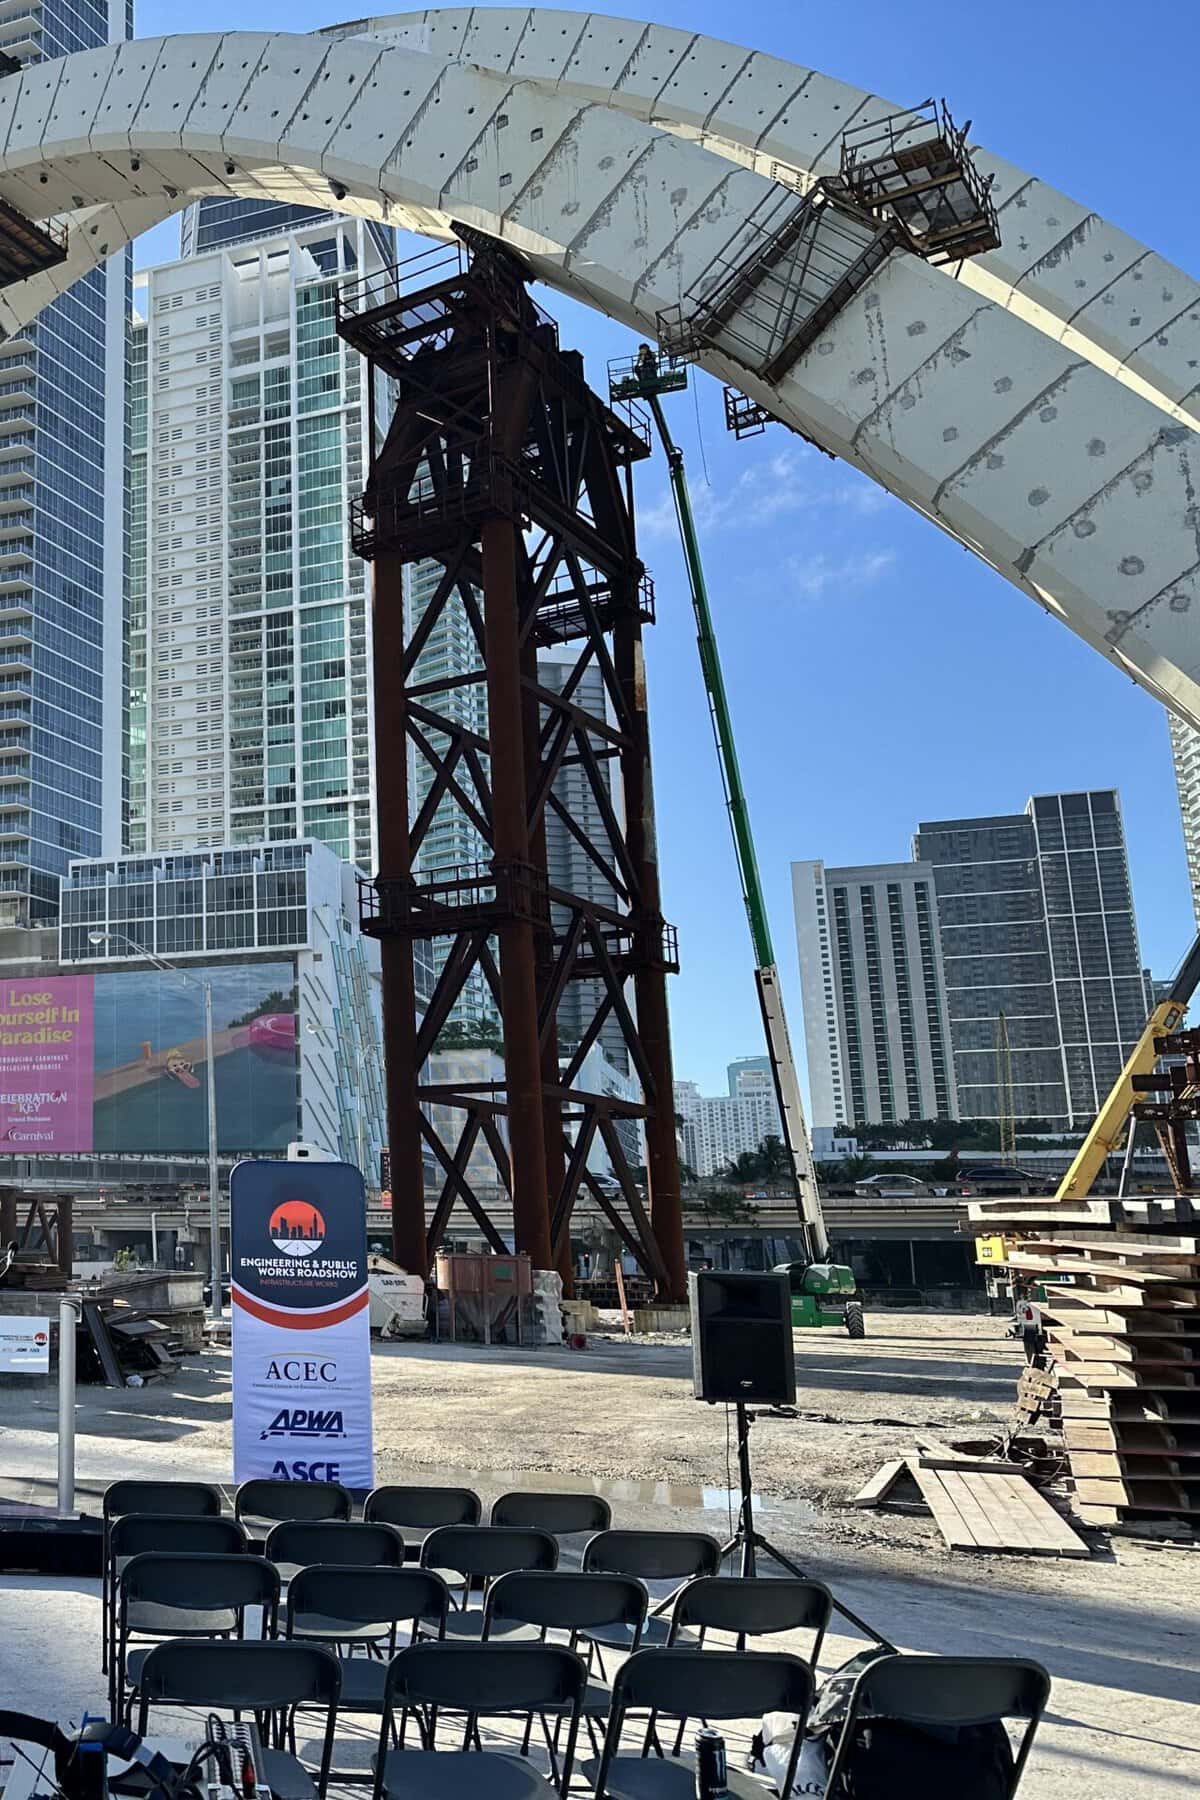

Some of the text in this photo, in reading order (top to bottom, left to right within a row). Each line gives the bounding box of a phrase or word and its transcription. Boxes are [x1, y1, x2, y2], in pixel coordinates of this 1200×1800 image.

[9, 990, 53, 1007] Lose
[62, 1006, 80, 1024] In
[0, 1063, 61, 1072] EXCLUSIVE PARADISE
[19, 1102, 41, 1114] KEY
[12, 1130, 54, 1141] Carnival
[240, 1258, 358, 1270] ENGINEERING & PUBLIC
[258, 1267, 358, 1279] WORKS ROADSHOW
[266, 1361, 337, 1382] ACEC
[268, 1409, 344, 1433] APWA
[271, 1460, 340, 1482] ASCE
